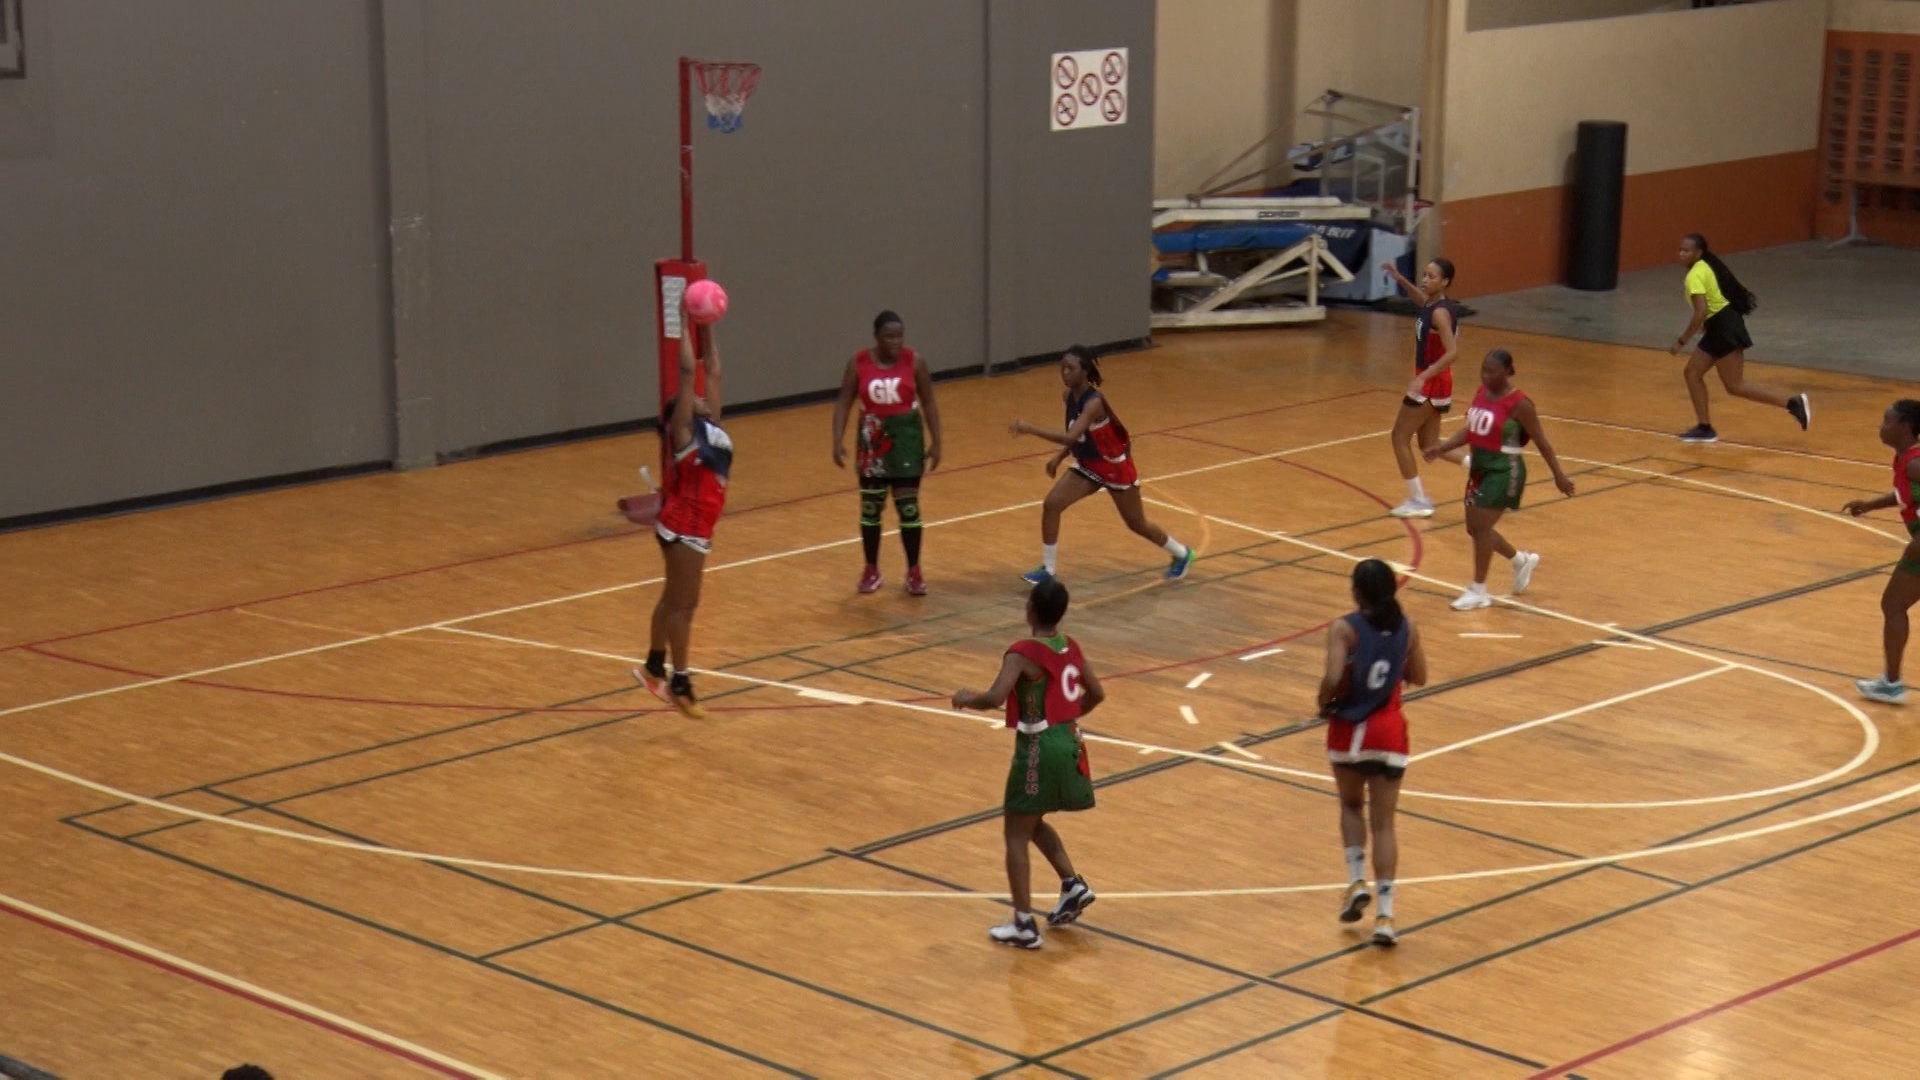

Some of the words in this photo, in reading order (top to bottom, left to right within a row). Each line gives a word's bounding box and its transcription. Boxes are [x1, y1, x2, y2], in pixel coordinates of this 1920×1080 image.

[868, 377, 902, 404] GK
[1061, 663, 1080, 702] C
[1367, 660, 1391, 690] C
